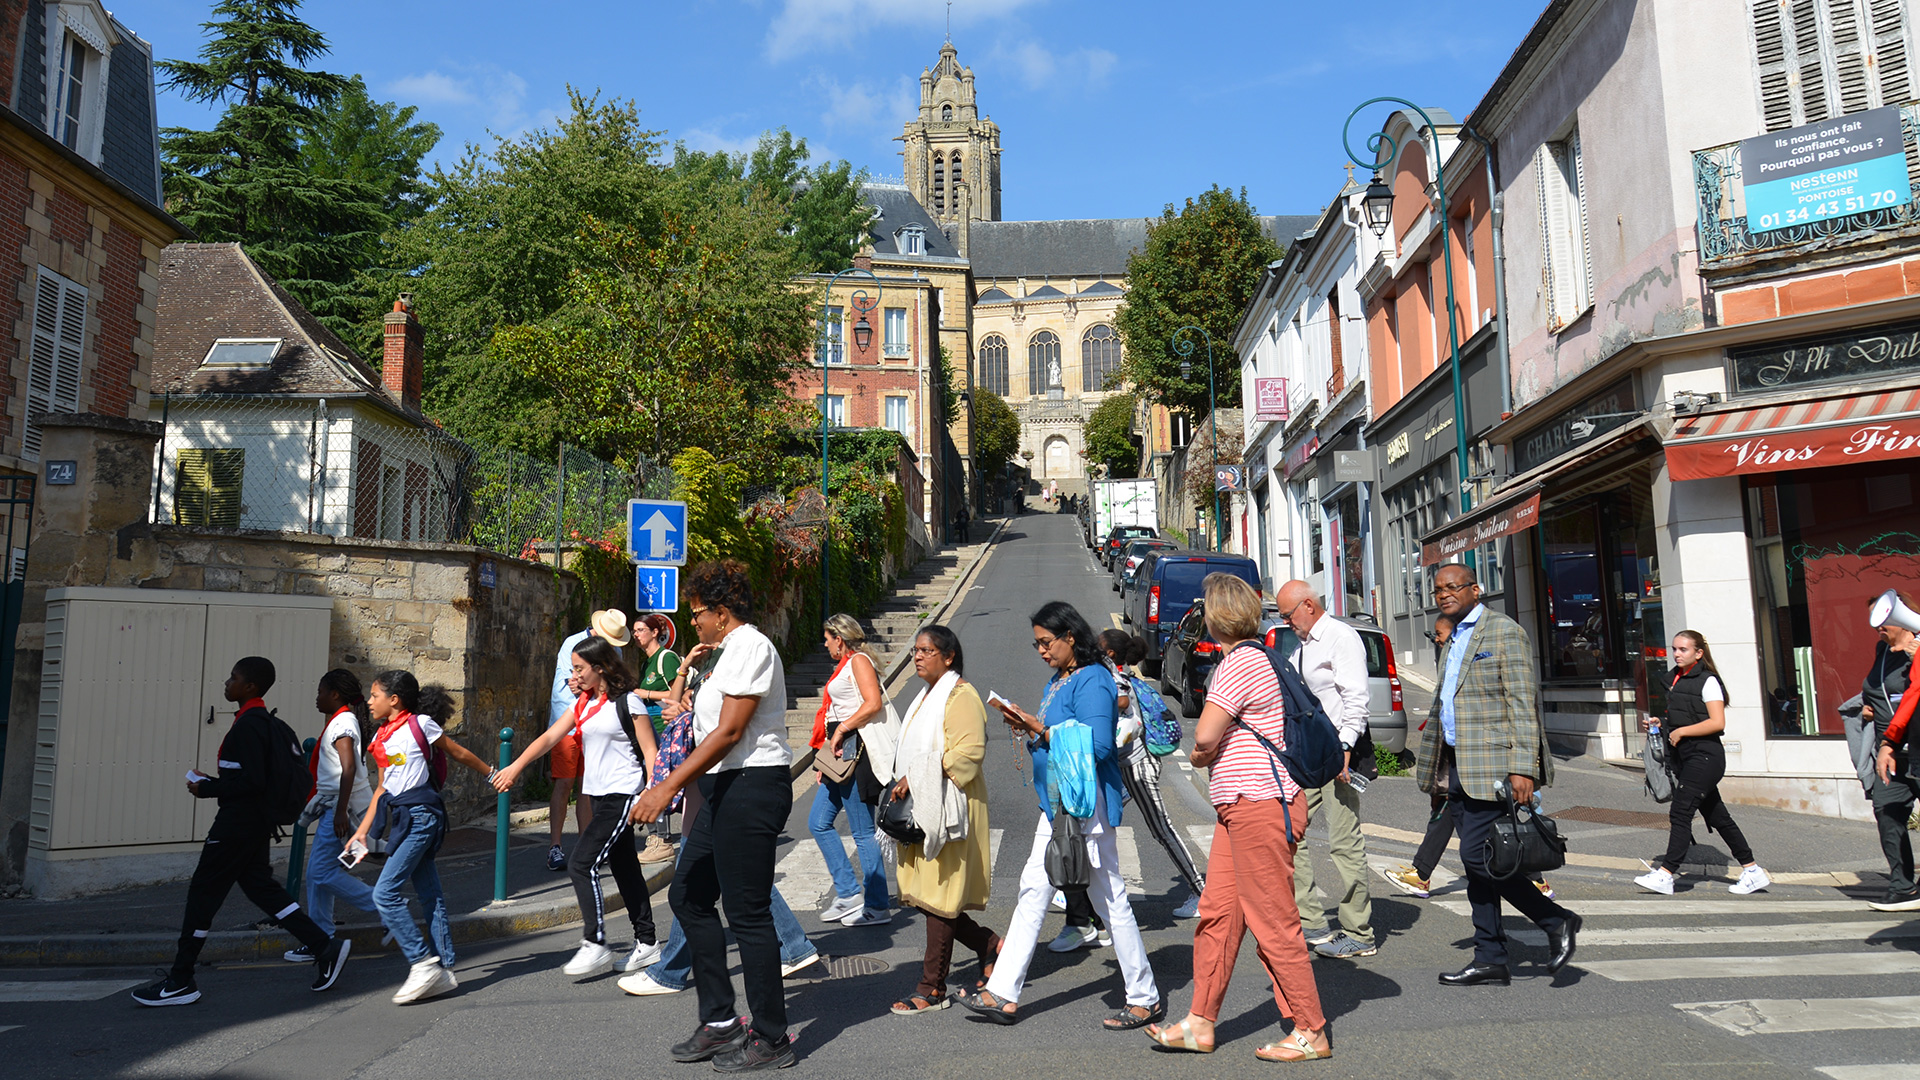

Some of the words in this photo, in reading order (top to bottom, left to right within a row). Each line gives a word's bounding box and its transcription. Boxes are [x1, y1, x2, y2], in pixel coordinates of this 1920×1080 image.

[1775, 139, 1788, 148] Ils
[1790, 132, 1818, 145] nous
[1820, 126, 1840, 138] ont
[1841, 121, 1862, 133] fait
[1791, 136, 1850, 155] confiance.
[1759, 153, 1815, 173] Pourquoi
[1818, 148, 1841, 162] pas
[1843, 140, 1874, 155] vous
[1798, 185, 1854, 204] PONTOISE
[1759, 212, 1780, 228] 01
[1785, 206, 1810, 223] 34
[1815, 200, 1840, 217] 43
[1845, 195, 1865, 211] 51
[1870, 189, 1897, 207] 70
[1804, 345, 1831, 373] Ph
[1723, 438, 1825, 467] Vins
[50, 464, 73, 480] 74
